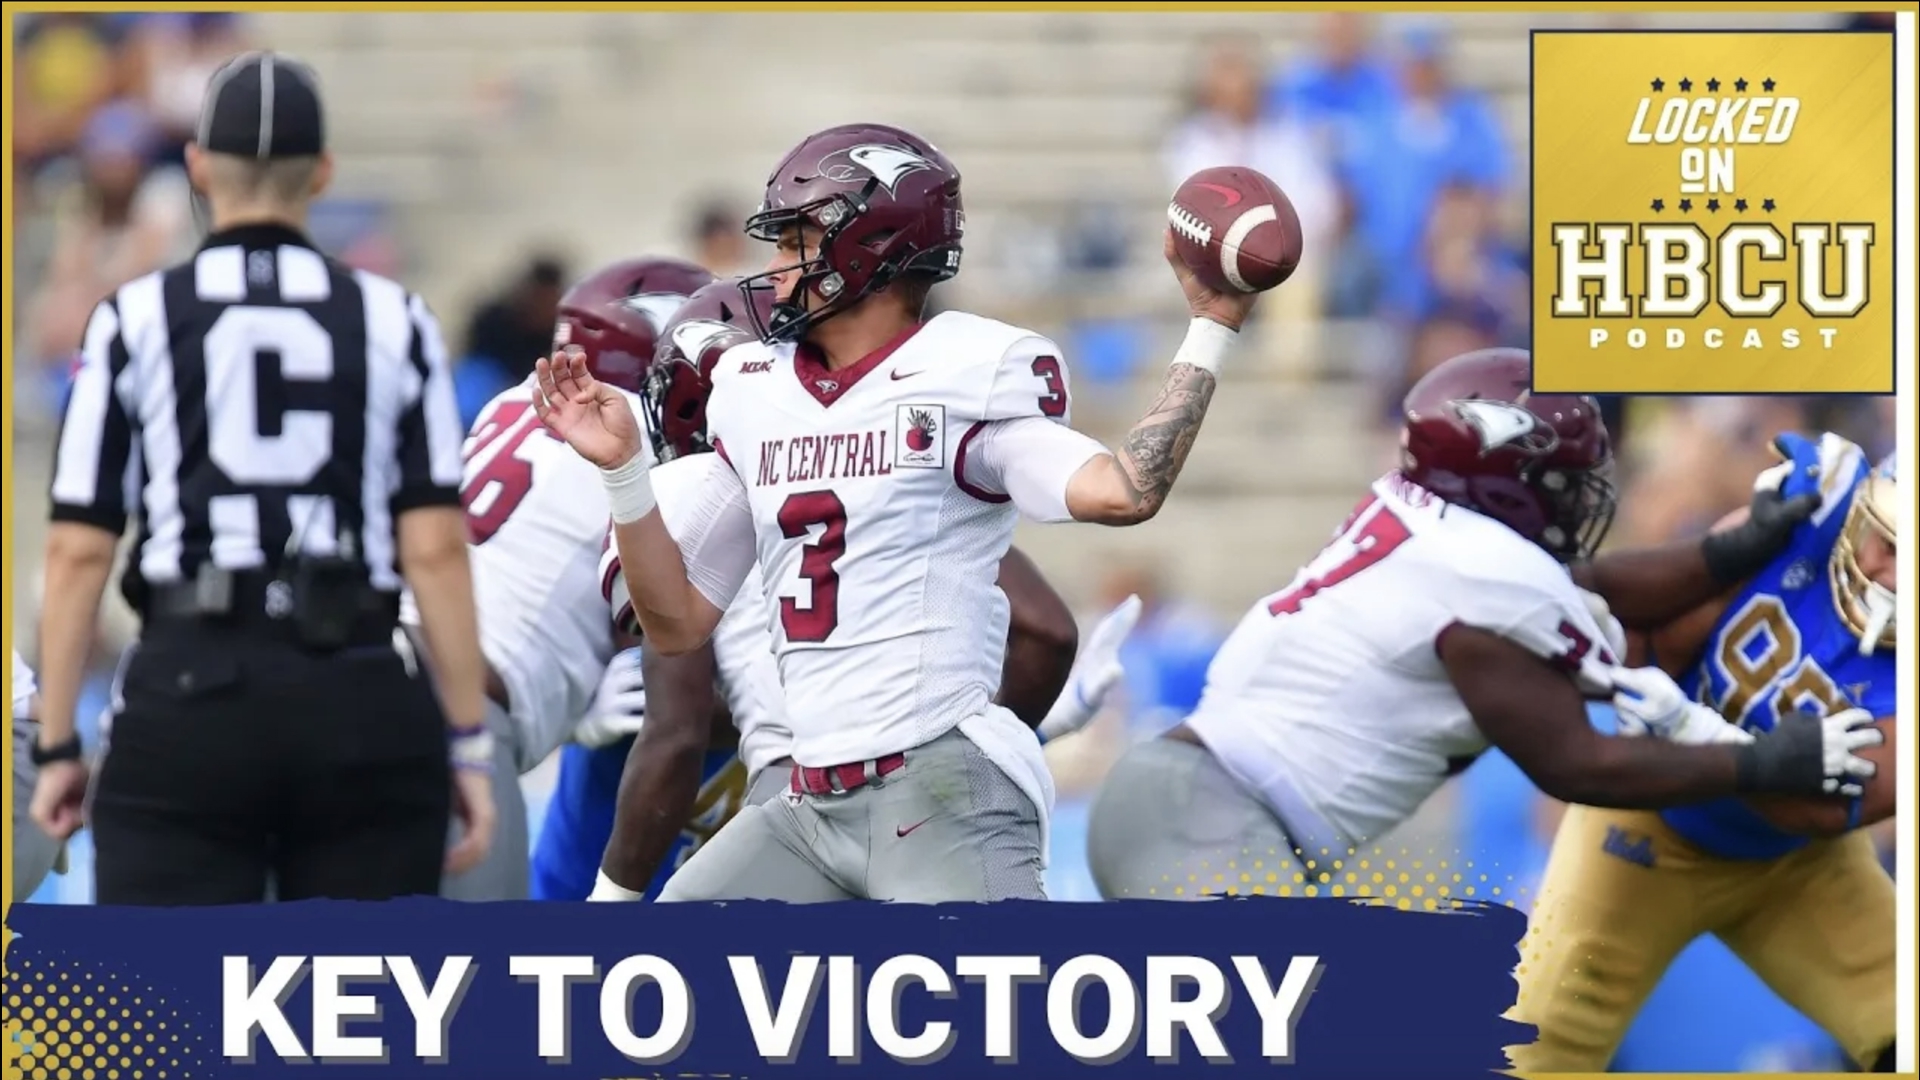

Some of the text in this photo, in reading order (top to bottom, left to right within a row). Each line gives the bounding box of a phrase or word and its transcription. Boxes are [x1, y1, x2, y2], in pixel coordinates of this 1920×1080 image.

[204, 306, 333, 485] C
[1030, 355, 1067, 418] 3
[756, 430, 891, 486] NC CENTRAL
[777, 489, 847, 643] 3
